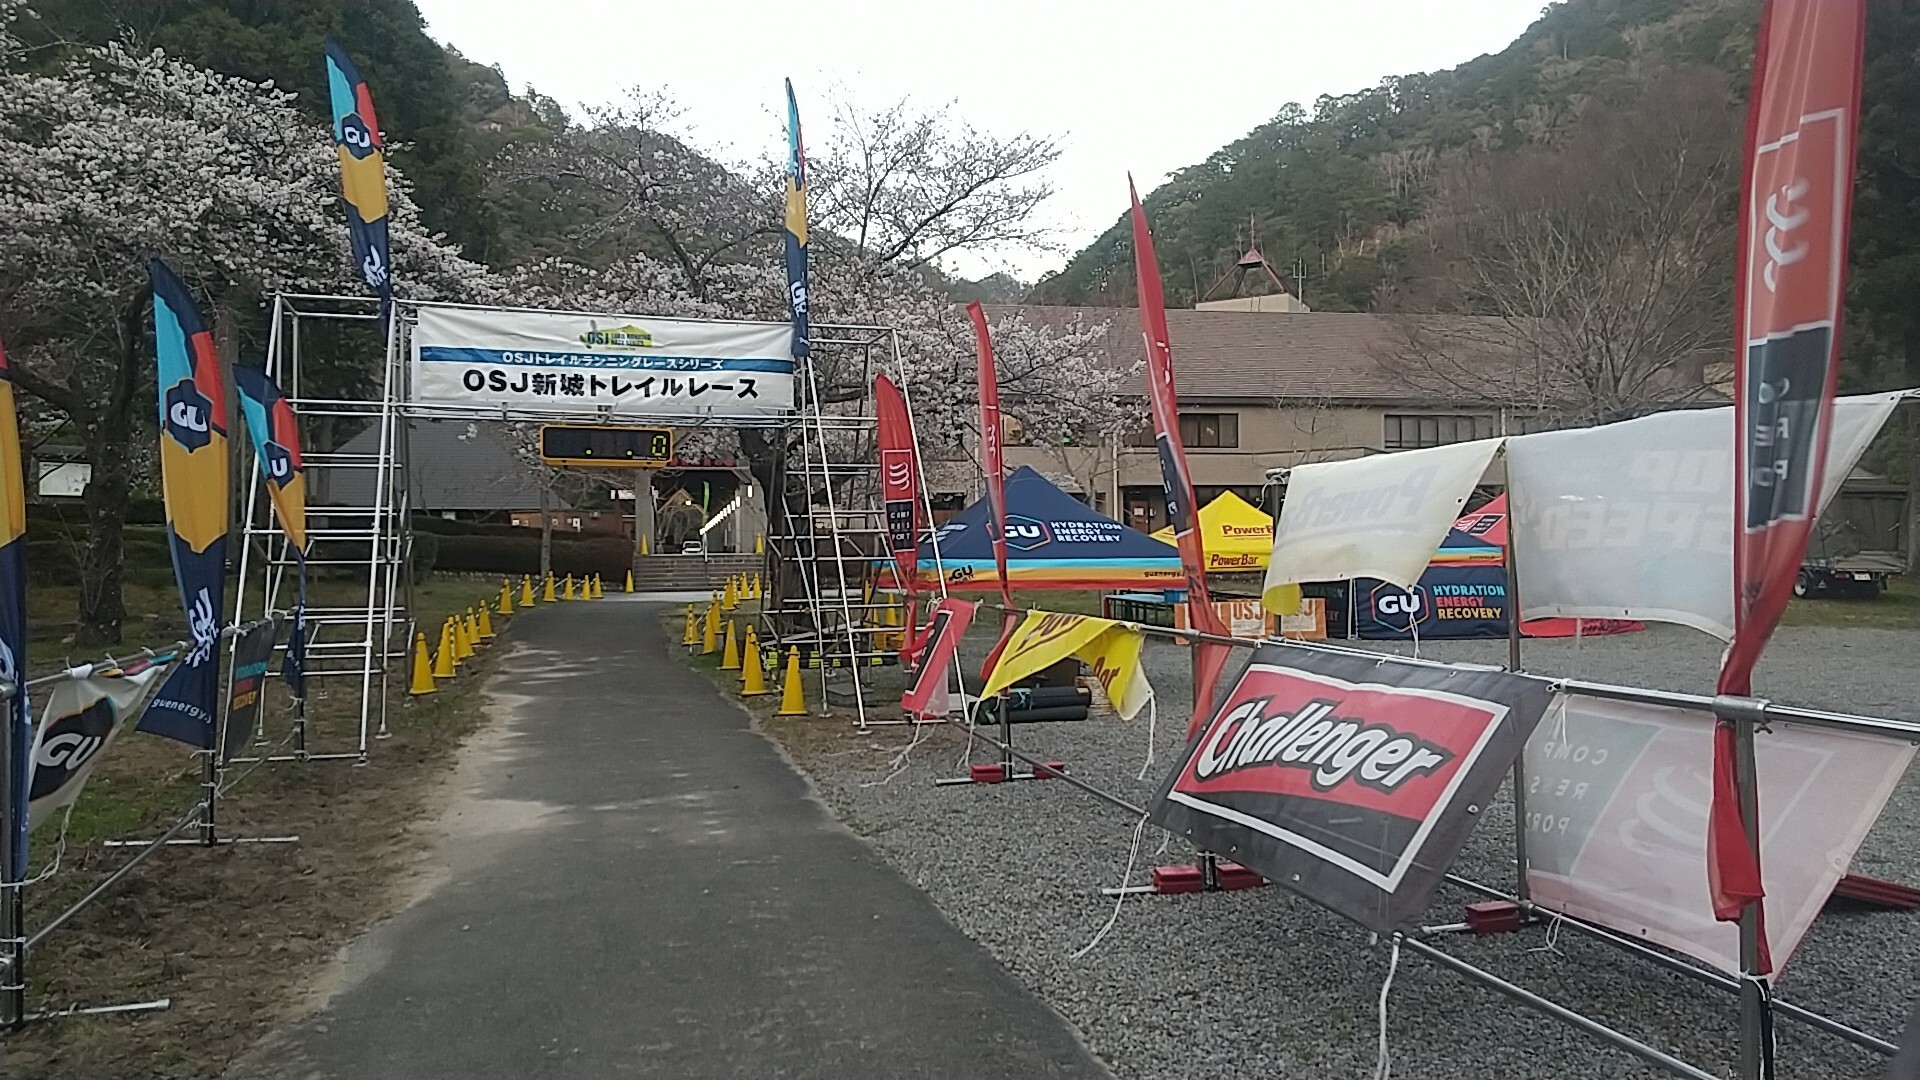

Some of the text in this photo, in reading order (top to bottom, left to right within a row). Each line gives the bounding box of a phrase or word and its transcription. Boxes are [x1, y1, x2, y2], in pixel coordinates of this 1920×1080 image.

[344, 126, 371, 148] GU
[502, 351, 723, 370] OSJトレイルランニングレースシリーズ
[463, 370, 758, 399] OSJ新城トレイルレース
[171, 401, 208, 432] GU
[271, 457, 288, 477] U
[1051, 521, 1122, 530] HYDRATION
[1057, 534, 1120, 542] RECOVERY
[1211, 553, 1258, 566] PowerBar
[1433, 585, 1505, 596] HYDRATION
[1379, 594, 1420, 614] GU
[1436, 597, 1485, 607] ENERGY
[1438, 608, 1502, 619] RECOVERY
[37, 734, 101, 770] GU
[1197, 699, 1442, 786] Challenger
